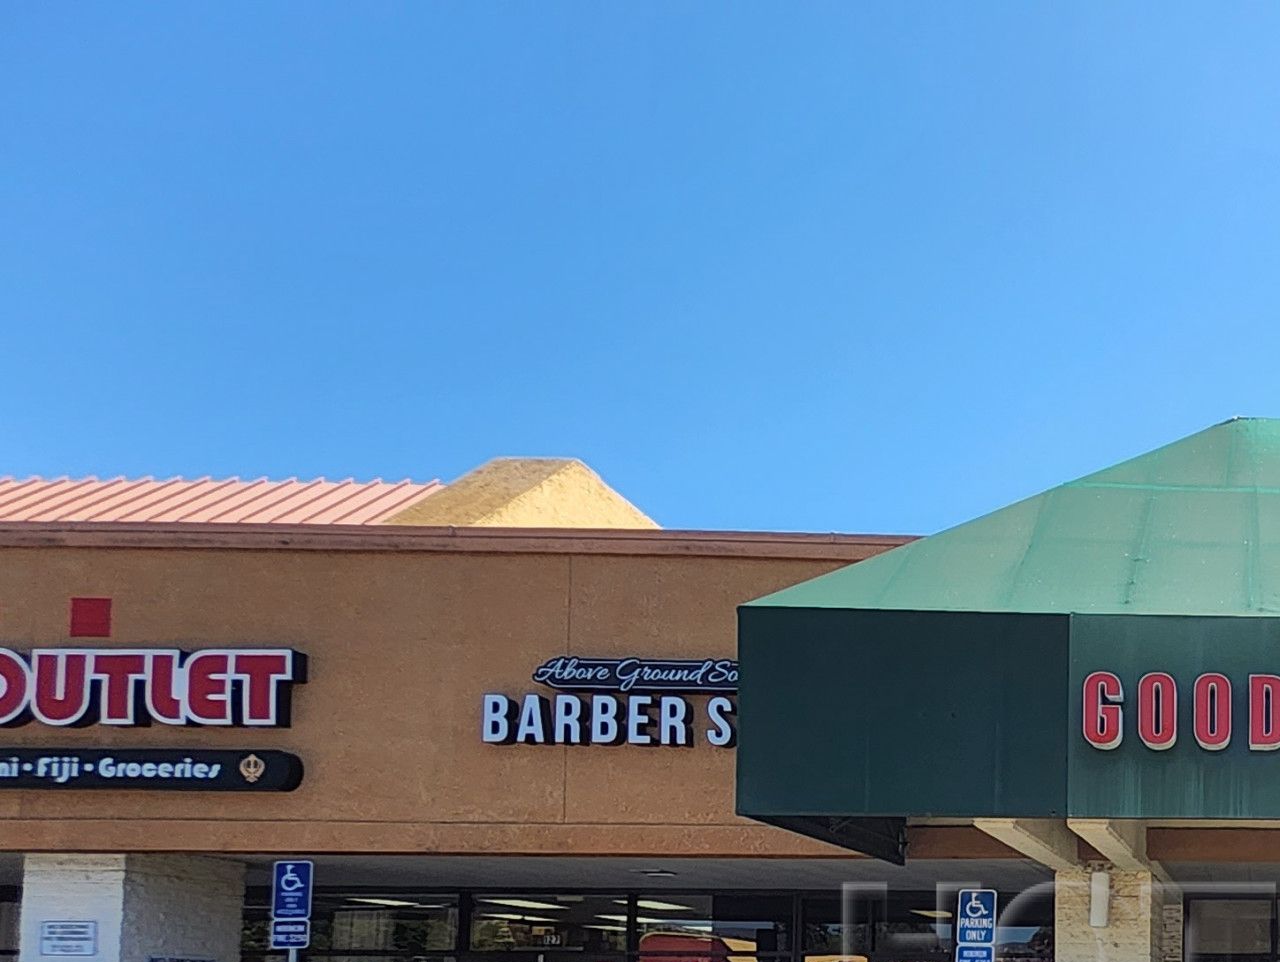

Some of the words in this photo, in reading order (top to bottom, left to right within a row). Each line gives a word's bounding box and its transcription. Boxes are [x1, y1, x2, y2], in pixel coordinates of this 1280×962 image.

[535, 658, 610, 681] Above
[616, 659, 710, 691] Ground
[482, 694, 686, 745] BARBER
[35, 757, 80, 783] Fiji
[100, 757, 222, 779] Groceries
[960, 918, 993, 930] PARKING
[966, 930, 986, 942] ONLY
